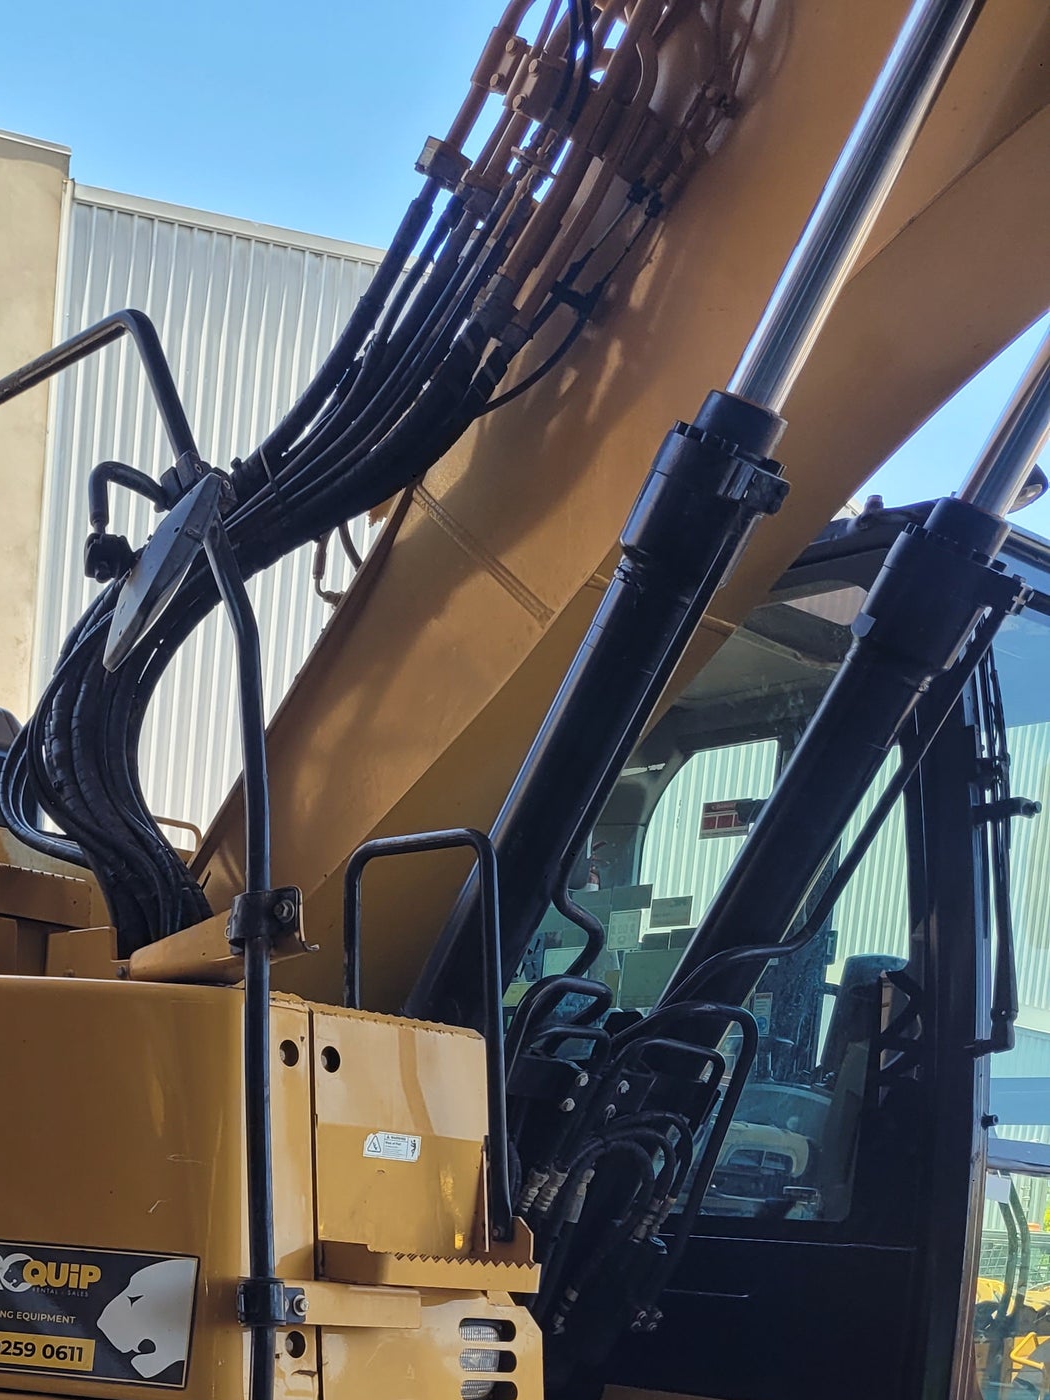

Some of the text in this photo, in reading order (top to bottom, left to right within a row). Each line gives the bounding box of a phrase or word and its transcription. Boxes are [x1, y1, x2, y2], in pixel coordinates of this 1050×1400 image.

[67, 1289, 89, 1298] SALES
[16, 1311, 77, 1324] EQUIPMENT
[42, 1344, 83, 1362] 0611
